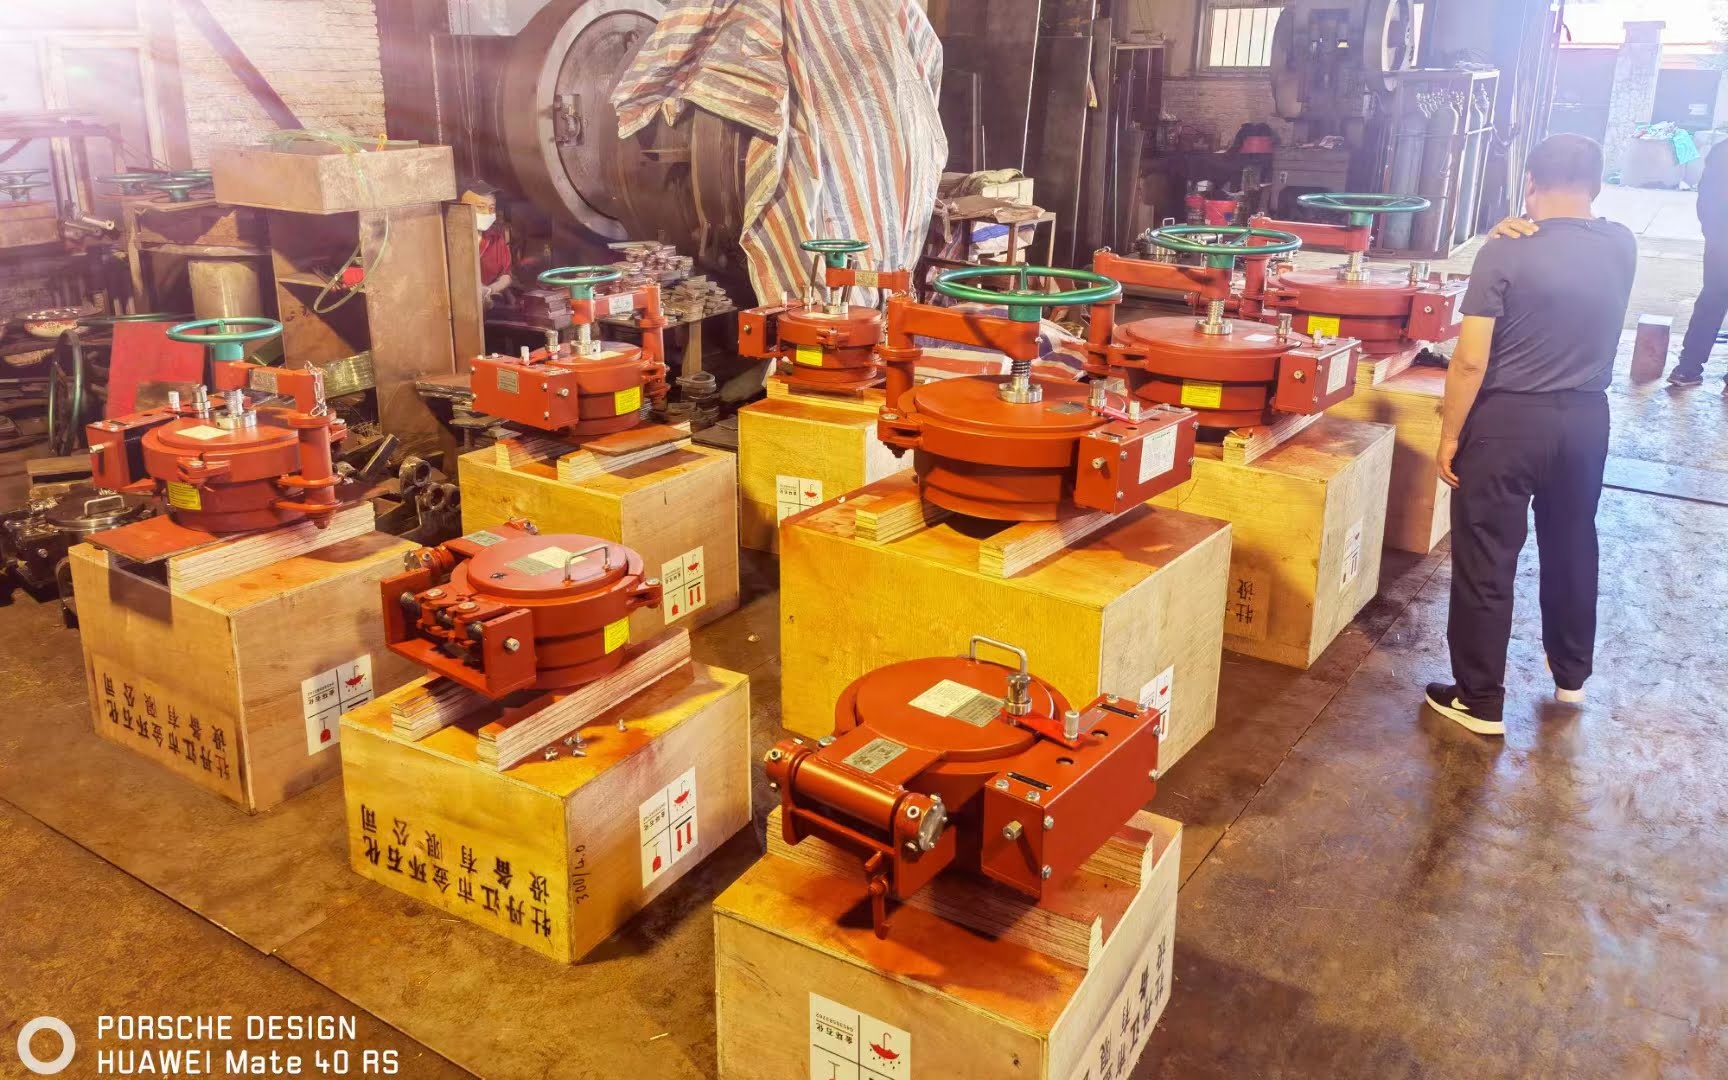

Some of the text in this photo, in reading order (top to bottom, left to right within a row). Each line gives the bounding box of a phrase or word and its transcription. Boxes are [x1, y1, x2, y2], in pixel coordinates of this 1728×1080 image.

[103, 673, 226, 753] 设备有限公司
[361, 804, 550, 905] 设备有限公司
[363, 835, 552, 938] 牡丹江市金环石化
[1082, 935, 1166, 1080] 设备有限
